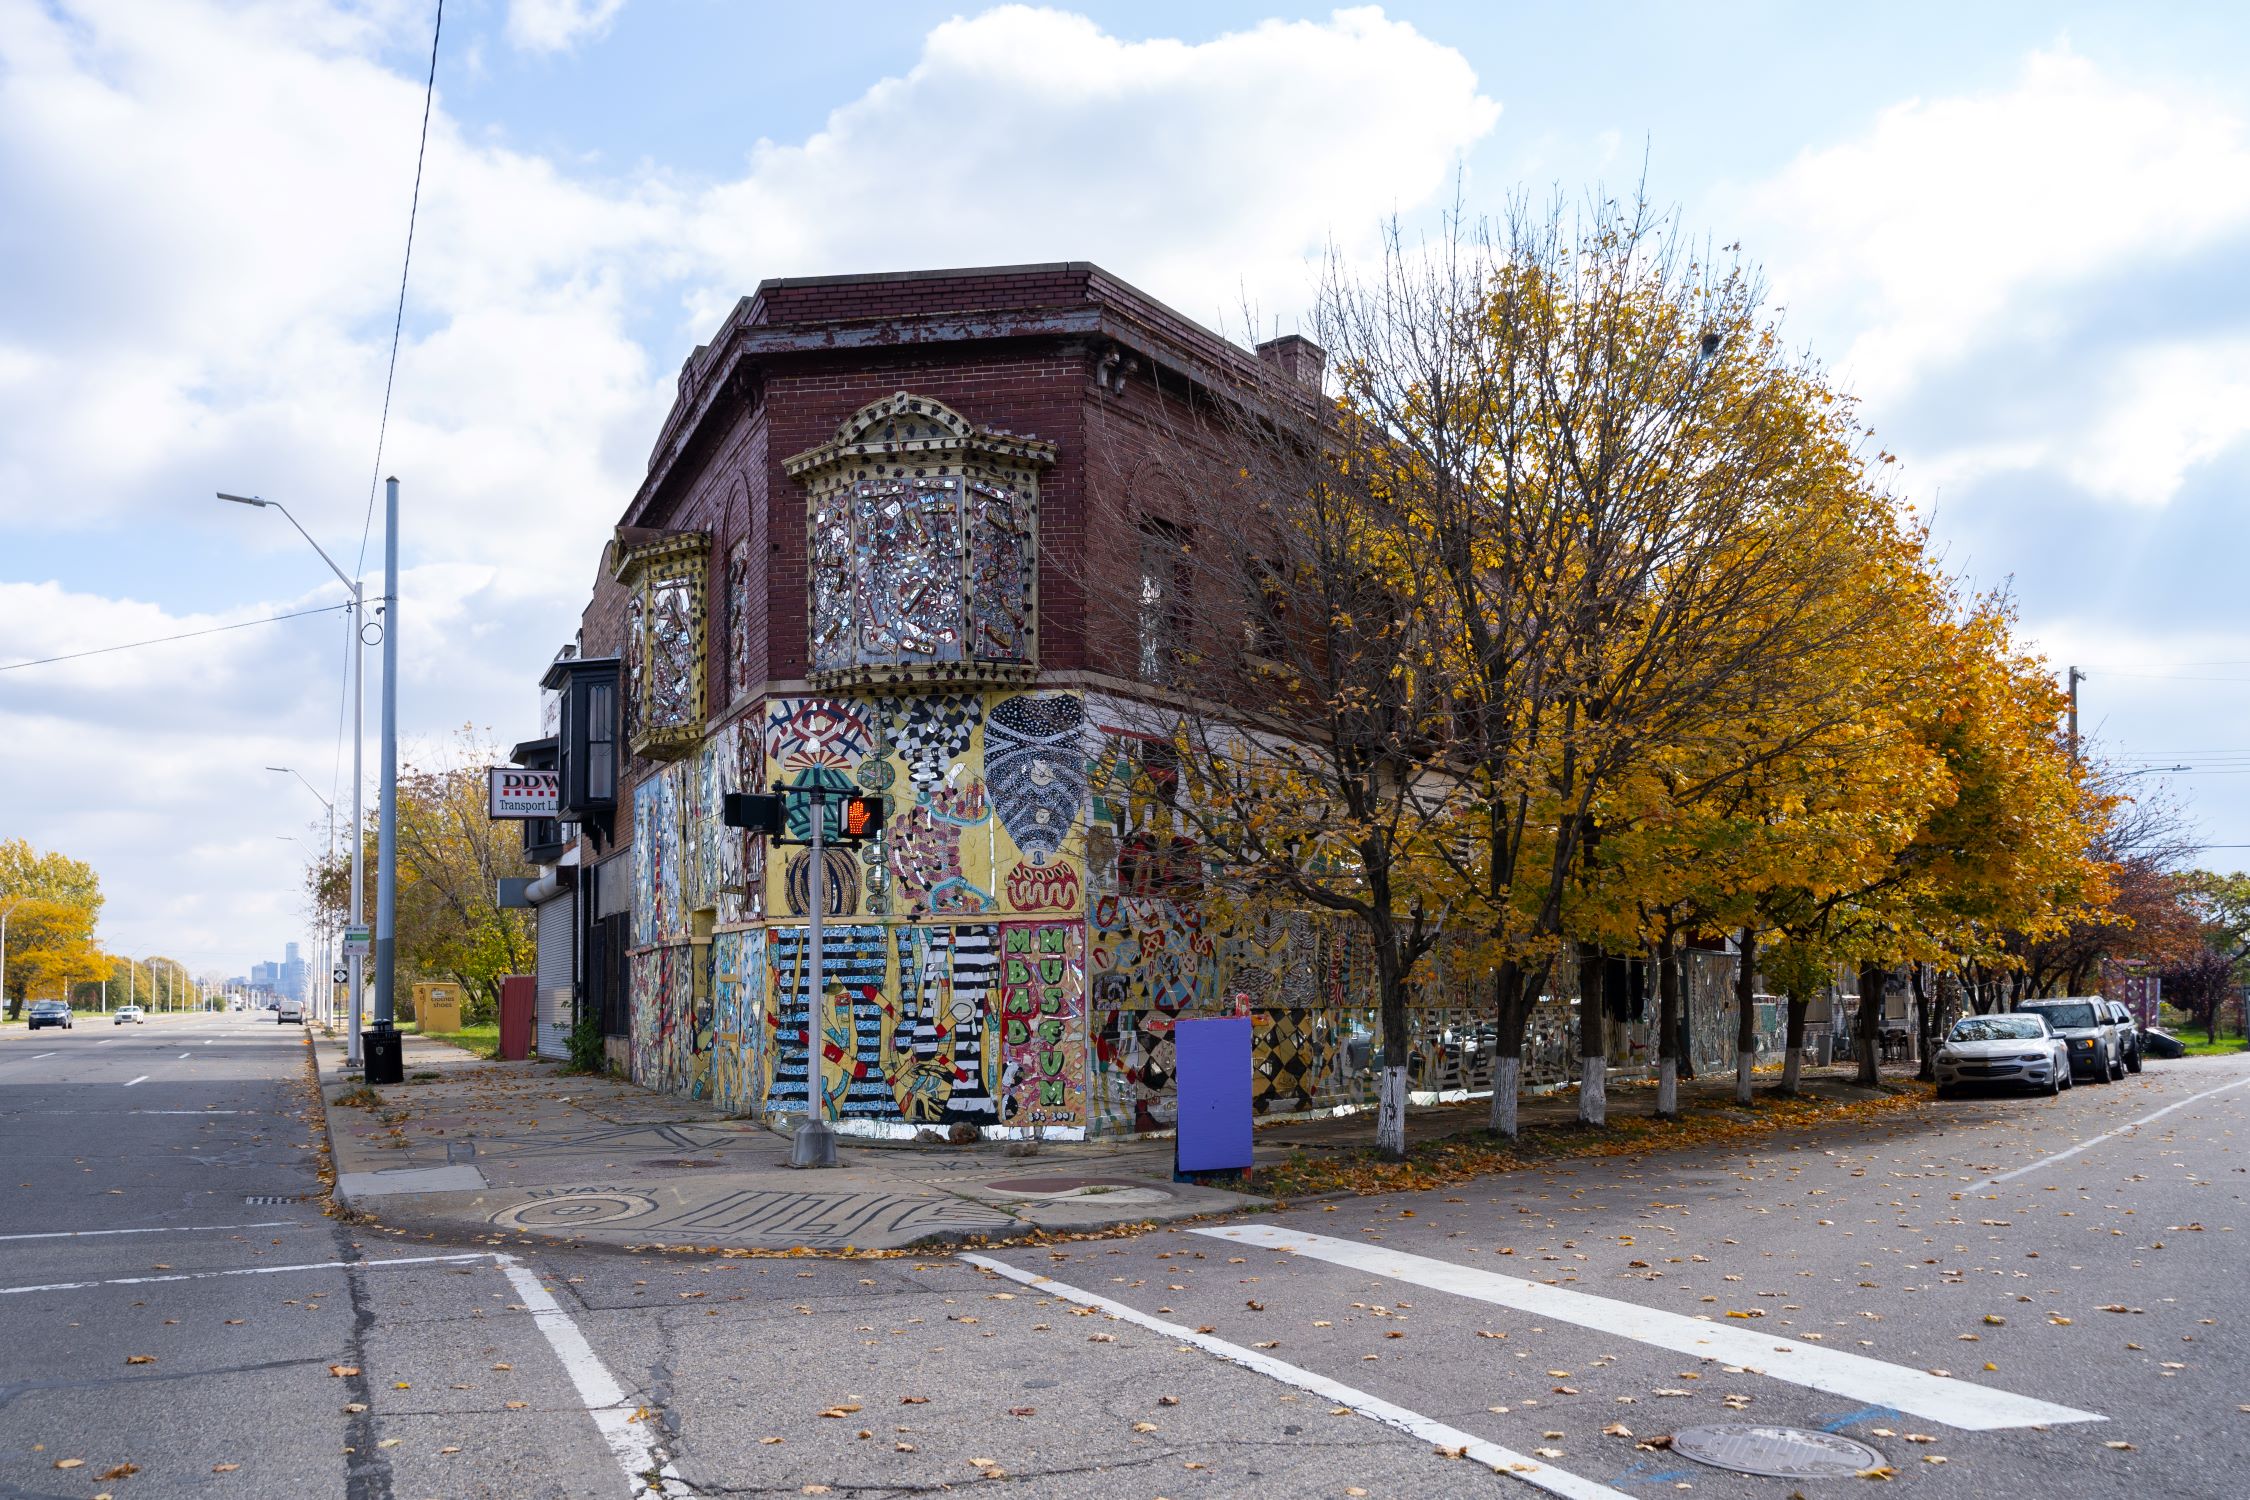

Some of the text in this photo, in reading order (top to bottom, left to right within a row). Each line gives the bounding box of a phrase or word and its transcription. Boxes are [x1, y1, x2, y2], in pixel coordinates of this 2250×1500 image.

[500, 800, 545, 813] Transport
[1006, 928, 1031, 1045] MBAD
[1038, 928, 1065, 1106] MUSEUM
[527, 1186, 658, 1199] NYAMA
